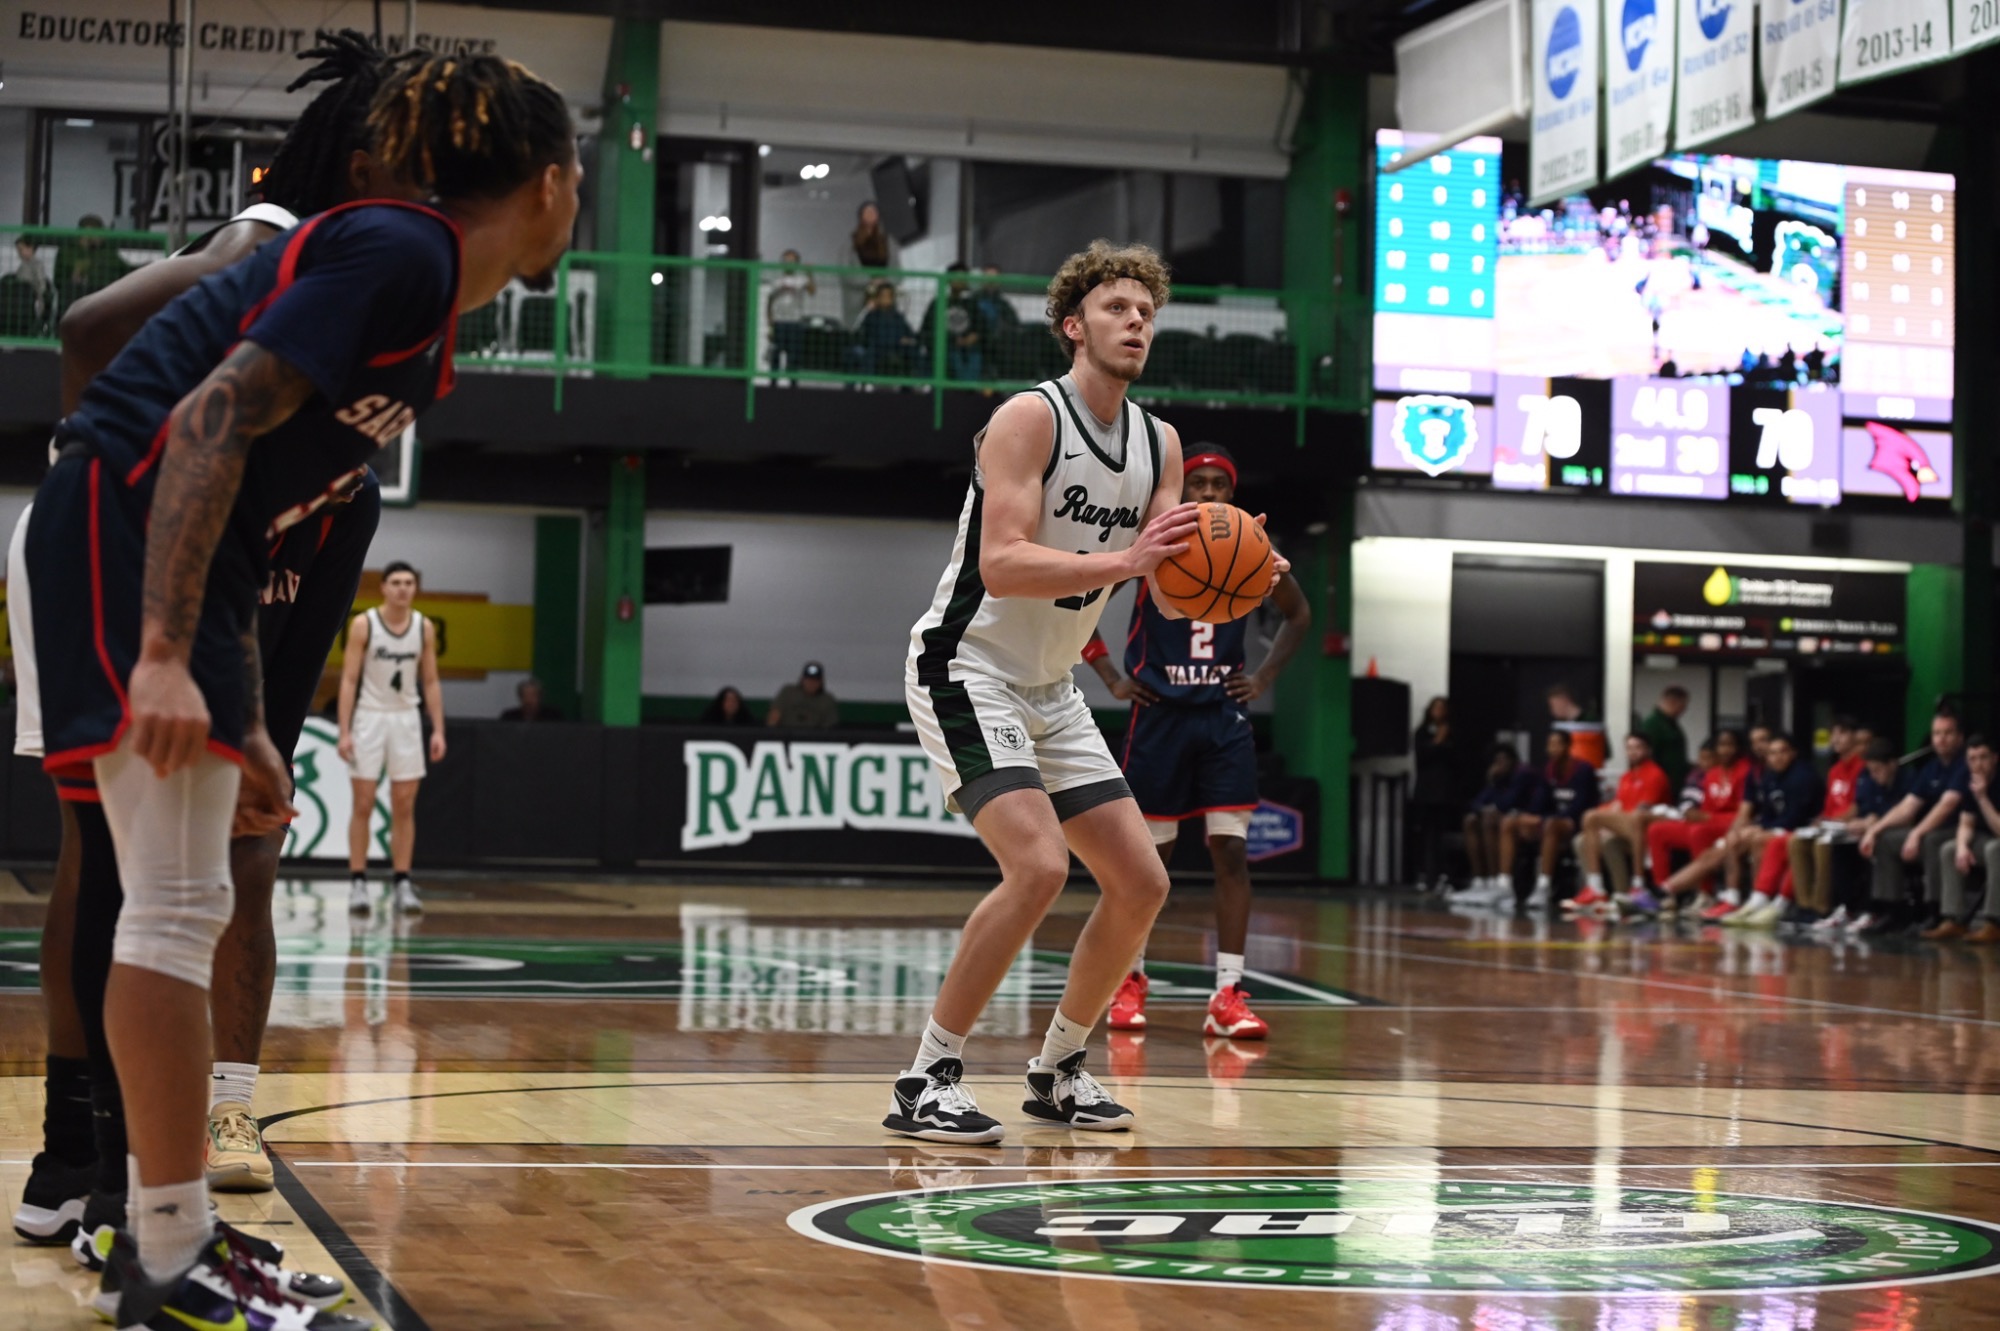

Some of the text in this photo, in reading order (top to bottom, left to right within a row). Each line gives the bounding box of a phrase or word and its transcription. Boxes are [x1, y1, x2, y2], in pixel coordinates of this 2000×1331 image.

[1970, 0, 2000, 35] 201
[199, 22, 306, 54] CREDIT
[1857, 20, 1933, 67] 2013-14
[1752, 407, 1814, 471] 70
[1190, 619, 1214, 659] 2
[389, 670, 402, 694] 4
[684, 741, 972, 850] RANGE
[1033, 1211, 1729, 1237] GLIAC
[1832, 1217, 1960, 1254] GREAT
